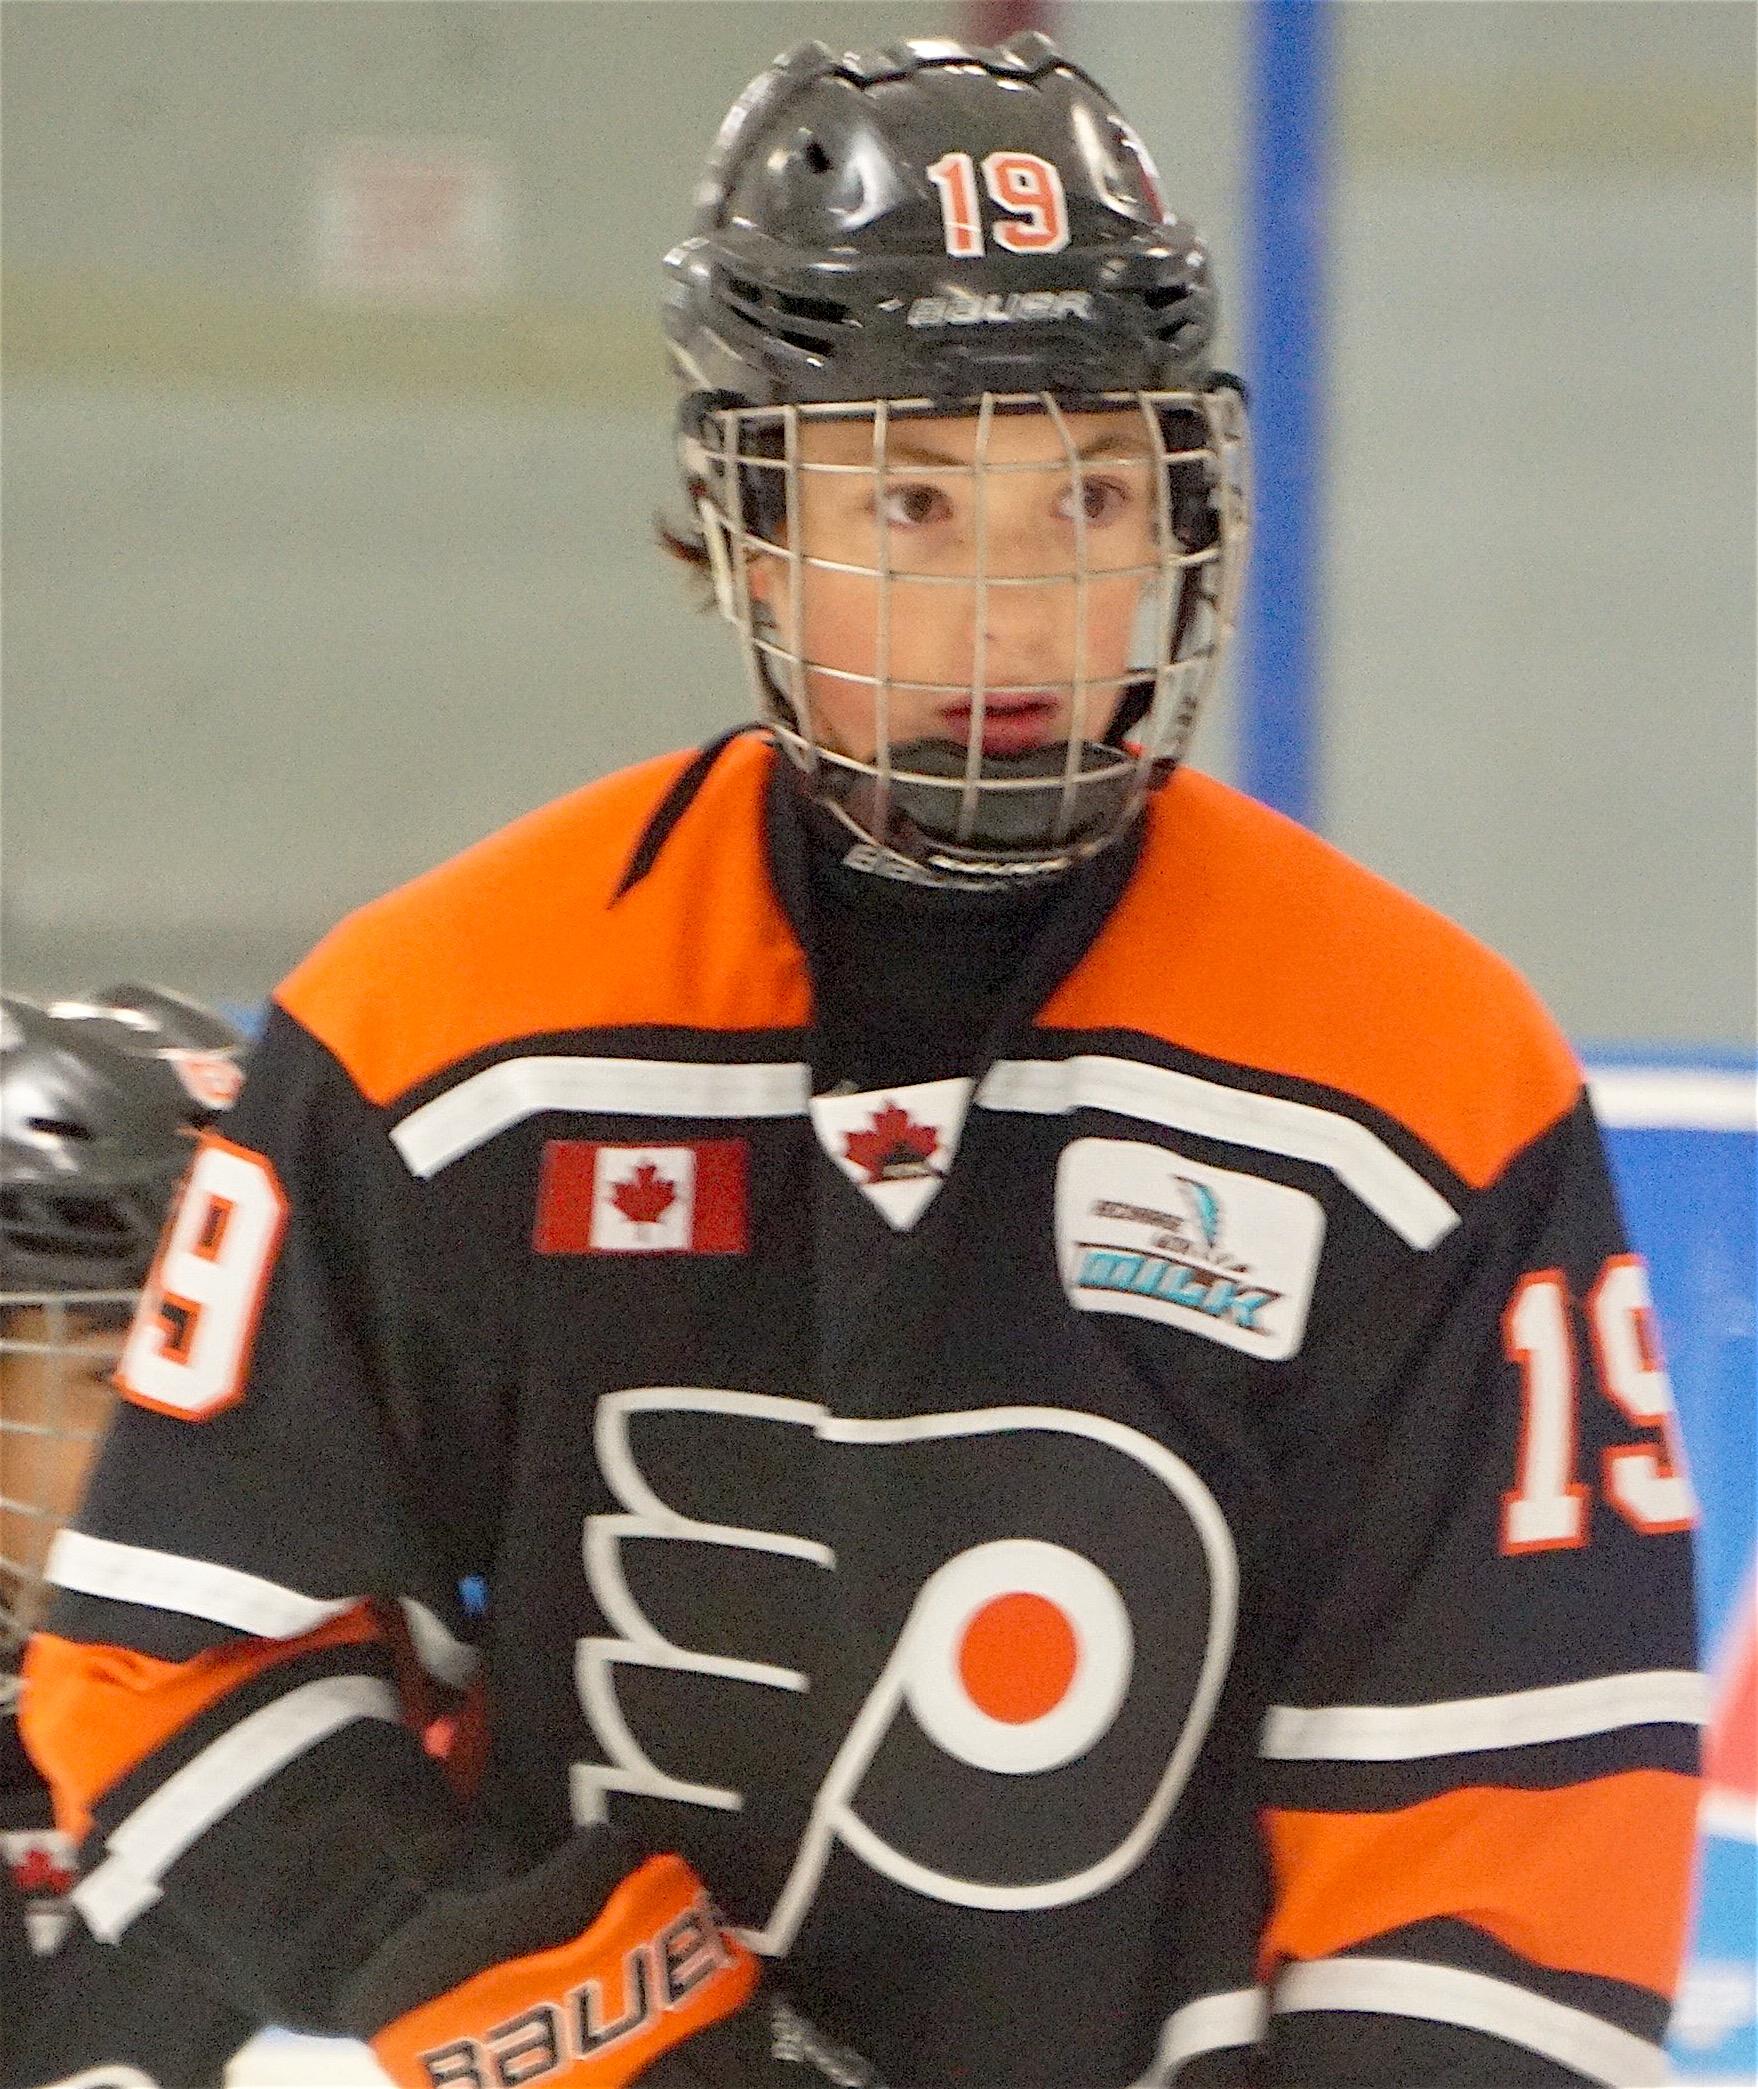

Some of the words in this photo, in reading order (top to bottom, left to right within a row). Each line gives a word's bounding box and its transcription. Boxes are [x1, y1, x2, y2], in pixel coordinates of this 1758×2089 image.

[927, 151, 1072, 258] 19
[1075, 1246, 1276, 1332] MILK
[1498, 1253, 1698, 1556] 19
[416, 1896, 739, 2089] BAUE
